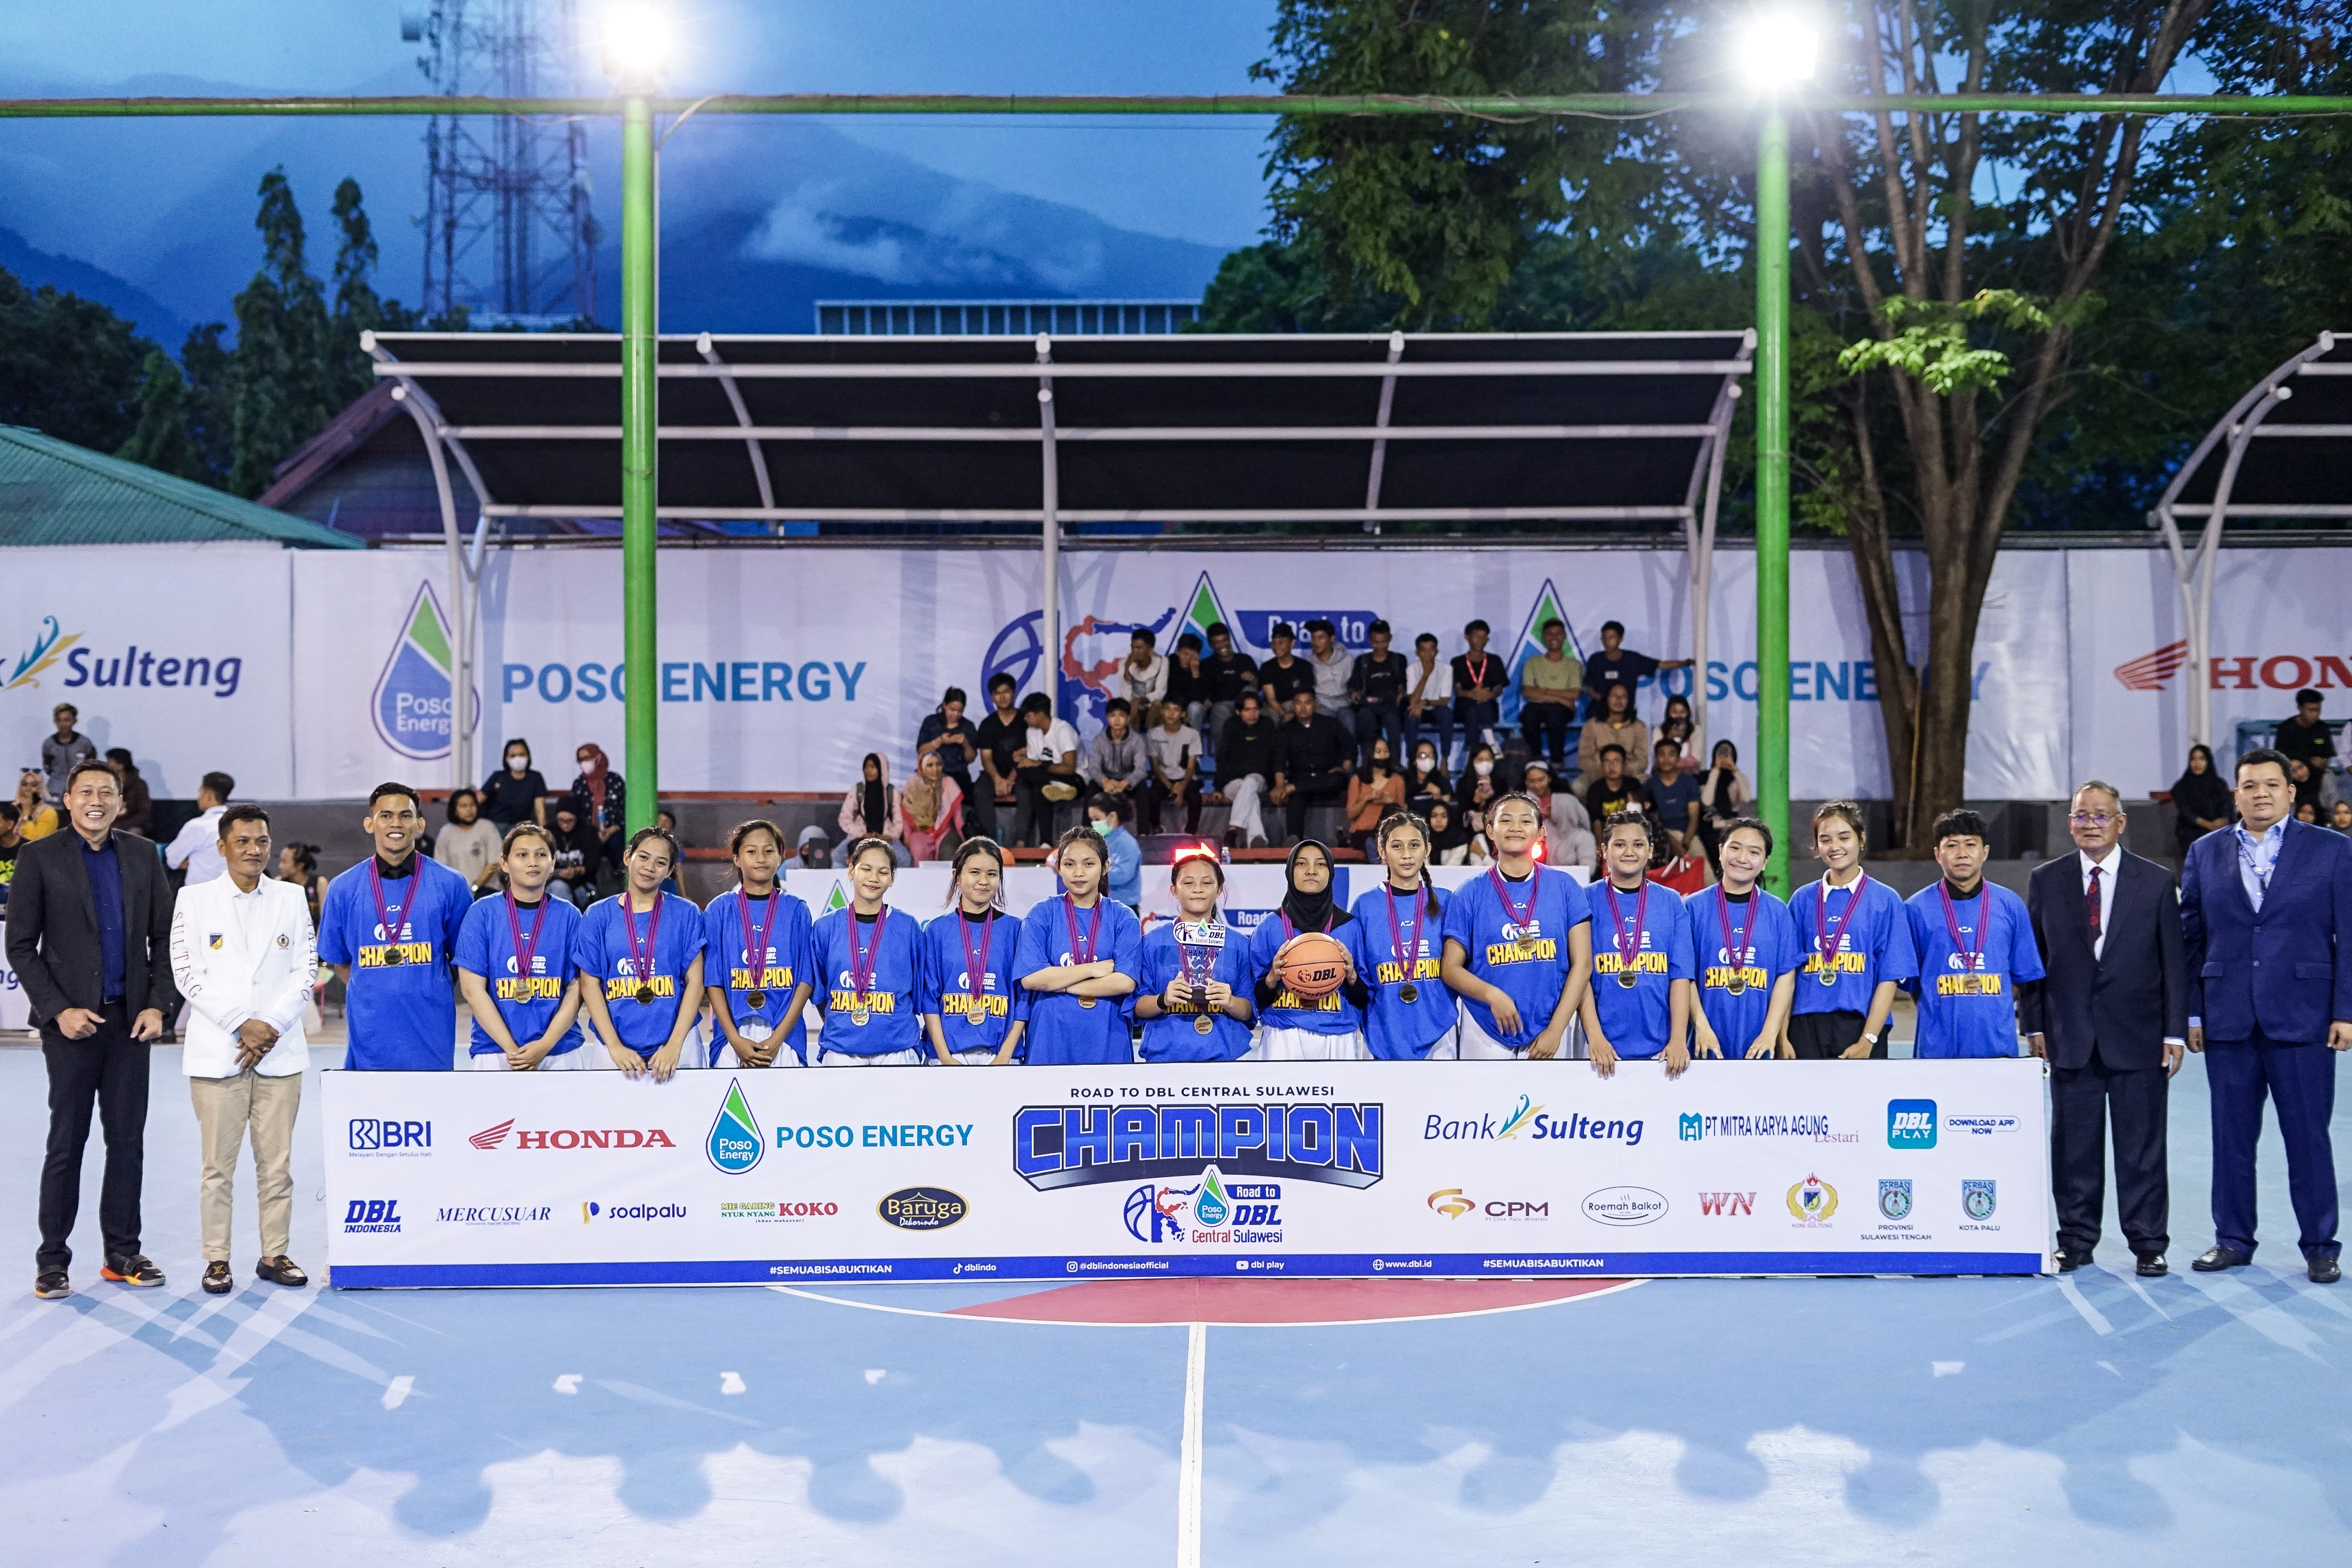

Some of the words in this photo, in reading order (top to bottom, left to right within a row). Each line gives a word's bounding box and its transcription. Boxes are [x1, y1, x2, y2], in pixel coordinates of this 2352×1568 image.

[1341, 616, 1365, 643] to
[64, 647, 241, 697] Sulteng
[662, 661, 867, 702] ENERGY
[397, 714, 452, 736] Energ
[172, 912, 203, 999] SULTENG
[1184, 949, 1219, 958] CHAMPION
[1312, 967, 1337, 982] DBL
[1070, 1088, 1113, 1098] ROAD
[1119, 1088, 1140, 1098] TO
[1145, 1087, 1175, 1098] DBL
[1181, 1086, 1251, 1097] CENTRAL
[1256, 1086, 1335, 1097] SULAWESI
[1705, 1116, 1717, 1136] PT
[1721, 1116, 1752, 1136] MITRA
[1755, 1116, 1788, 1136] KARYA
[1791, 1115, 1829, 1135] AGUNG
[1892, 1113, 1932, 1129] DBL
[383, 1121, 431, 1147] BRI
[776, 1126, 854, 1149] POSO
[862, 1124, 974, 1147] ENERGY
[1424, 1113, 1497, 1140] Bank
[1532, 1113, 1644, 1146] Sulteng
[1814, 1130, 1859, 1143] Lestari
[1892, 1130, 1931, 1138] PLAY
[517, 1129, 676, 1149] HONDA
[719, 1138, 752, 1150] Poso
[1013, 1103, 1383, 1182] CHAMPION
[719, 1150, 754, 1162] Energy
[1236, 1186, 1261, 1198] Road
[1265, 1186, 1276, 1198] to
[1879, 1181, 1910, 1193] PERBASI
[1964, 1181, 1995, 1193] PERBASI
[779, 1202, 838, 1216] KOKO
[887, 1199, 962, 1219] Baruga
[1485, 1201, 1548, 1217] CPM
[1588, 1202, 1629, 1211] Roemah
[1631, 1201, 1662, 1210] Balkot
[1698, 1192, 1757, 1215] WN
[344, 1199, 402, 1223] DBL
[435, 1206, 552, 1222] MERCUSUAR
[609, 1203, 687, 1221] soalpalu
[1232, 1205, 1282, 1225] DBL
[344, 1225, 402, 1233] INDONESIA
[899, 1217, 939, 1227] Dekorindo
[1192, 1229, 1231, 1243] Central
[1233, 1229, 1282, 1243] Sulawesi
[769, 1264, 893, 1275] #SEMUABISABUKTIKAN
[964, 1262, 997, 1272] dblindo
[1079, 1261, 1169, 1271] @dblindonesiaofficial
[1250, 1260, 1263, 1269] dbl
[1264, 1260, 1285, 1270] play
[1385, 1259, 1432, 1269] www.dbl.id
[1483, 1258, 1604, 1268] #SEMUABISABUKTIKAN
